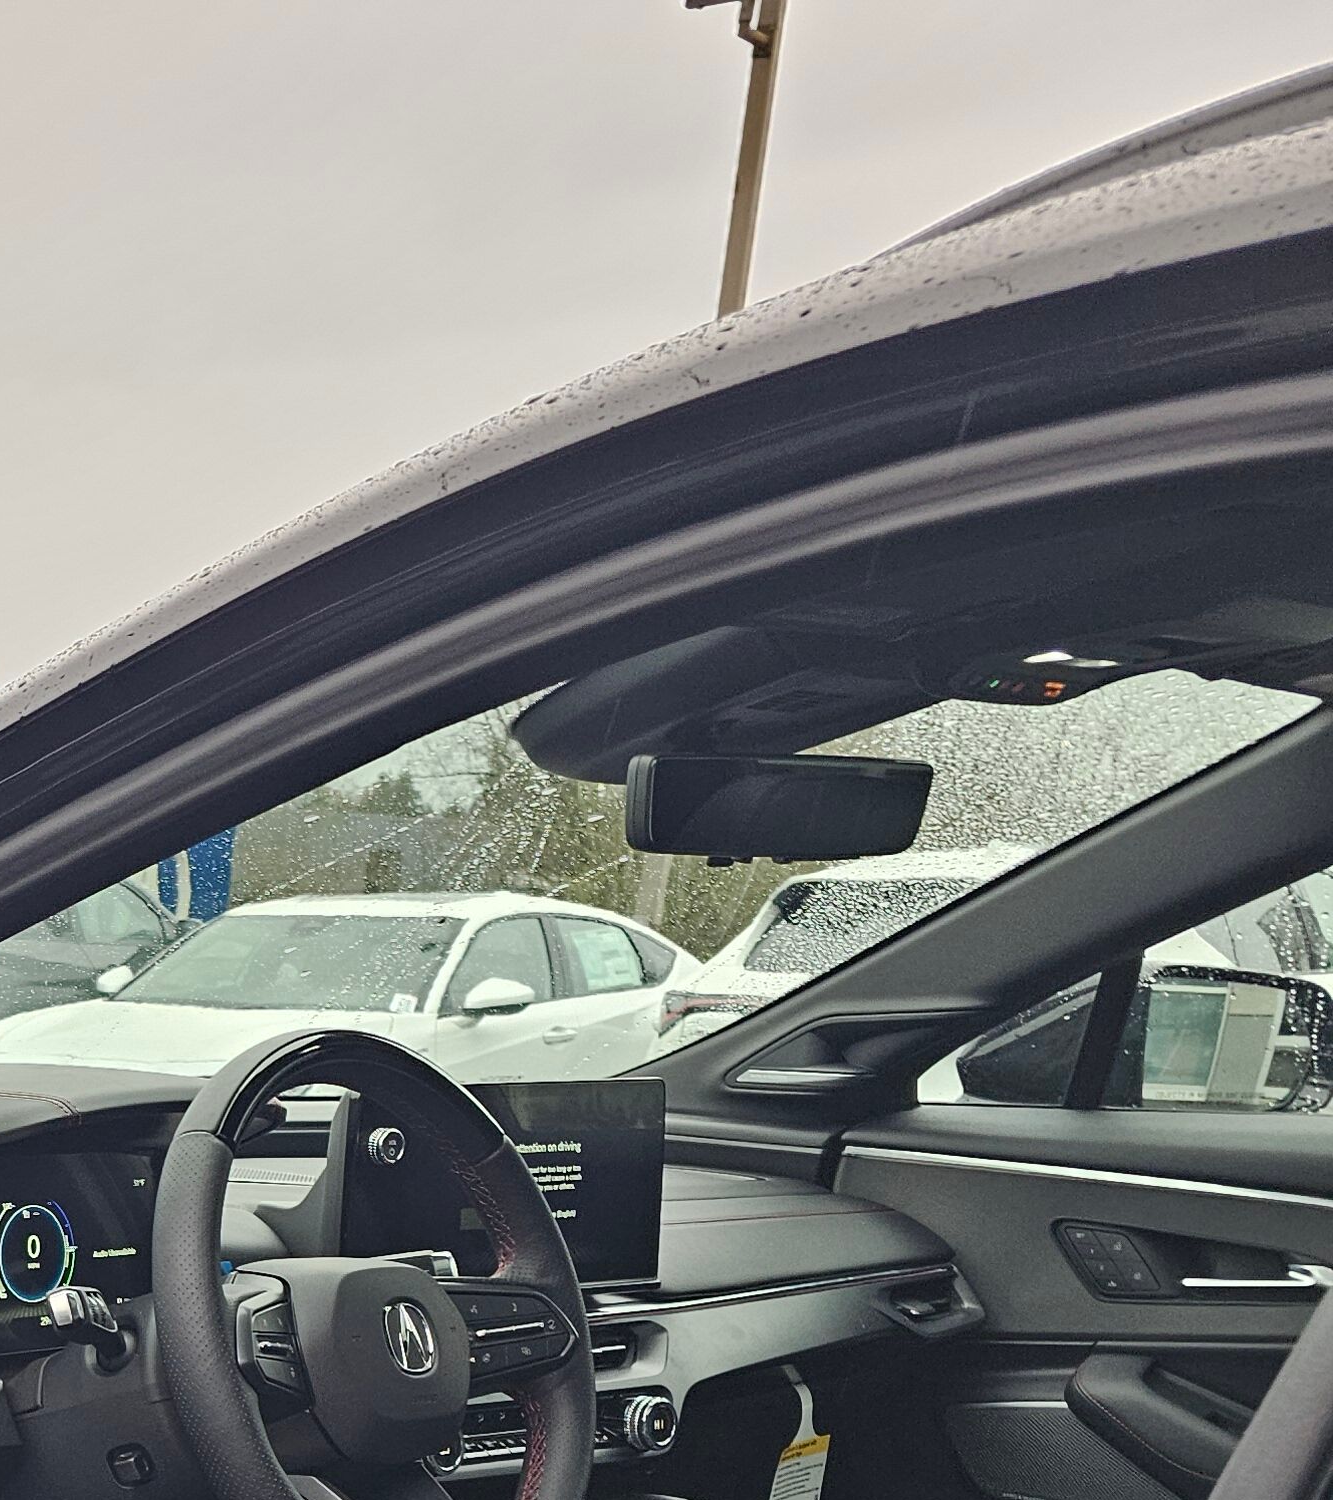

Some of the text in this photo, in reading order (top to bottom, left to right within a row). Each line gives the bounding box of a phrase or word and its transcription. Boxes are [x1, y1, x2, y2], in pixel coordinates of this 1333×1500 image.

[547, 1143, 557, 1152] on
[558, 1141, 581, 1153] driving
[27, 1234, 41, 1259] 0
[653, 1419, 664, 1430] HI
